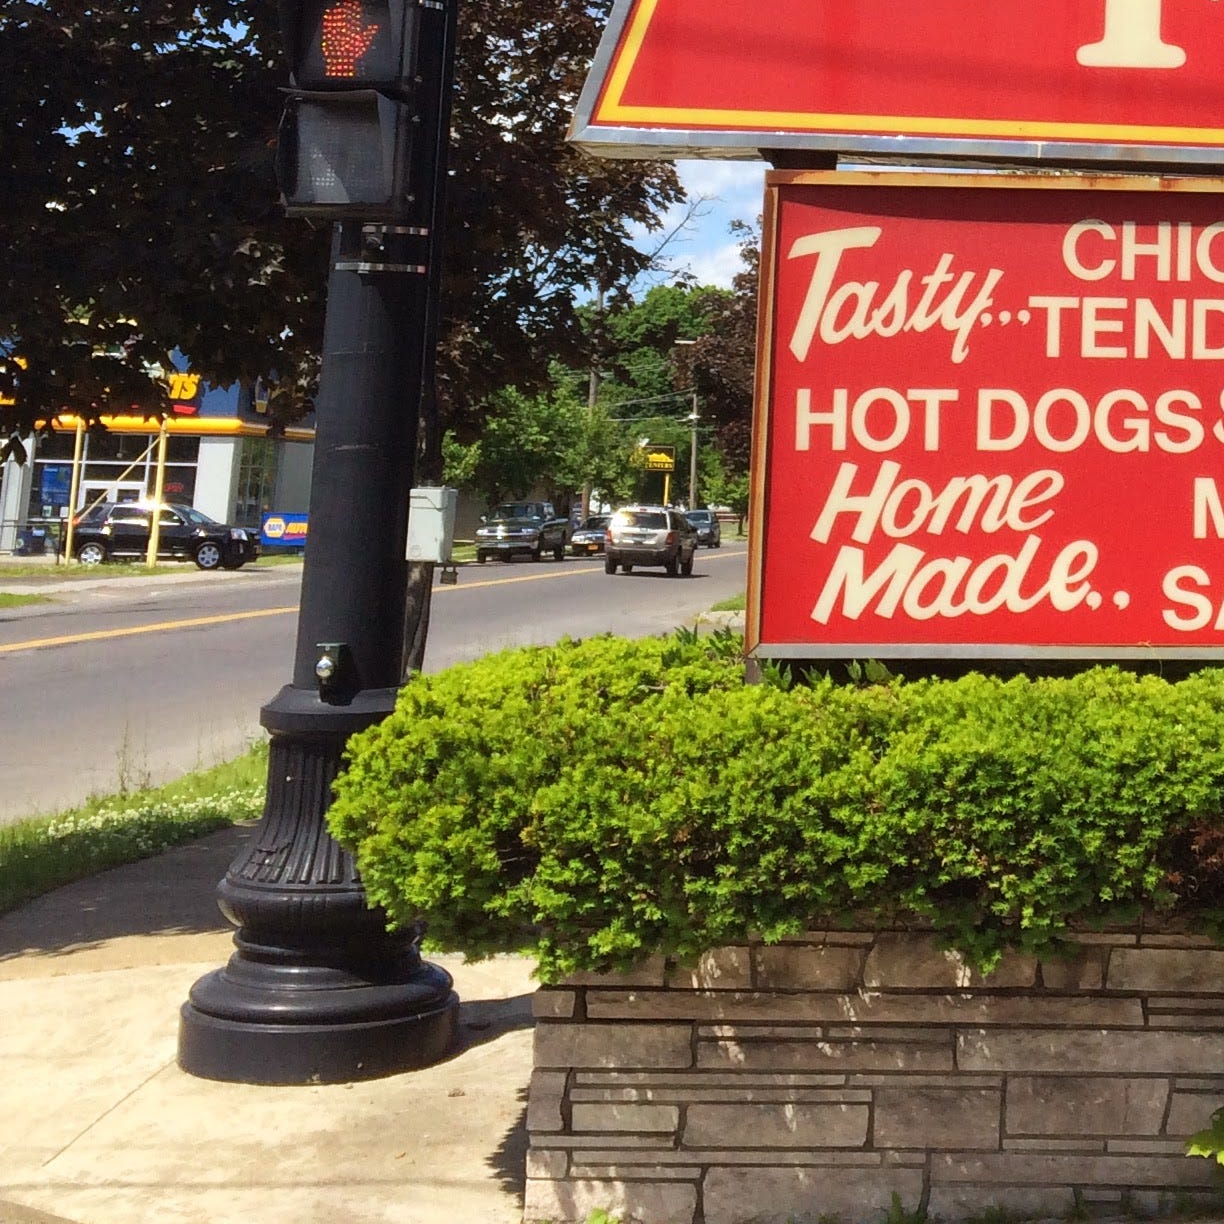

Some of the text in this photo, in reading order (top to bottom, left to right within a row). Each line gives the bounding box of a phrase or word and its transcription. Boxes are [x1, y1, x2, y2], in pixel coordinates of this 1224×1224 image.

[795, 388, 959, 453] HOT
[976, 388, 1205, 454] DOGS
[810, 459, 1065, 544] Home
